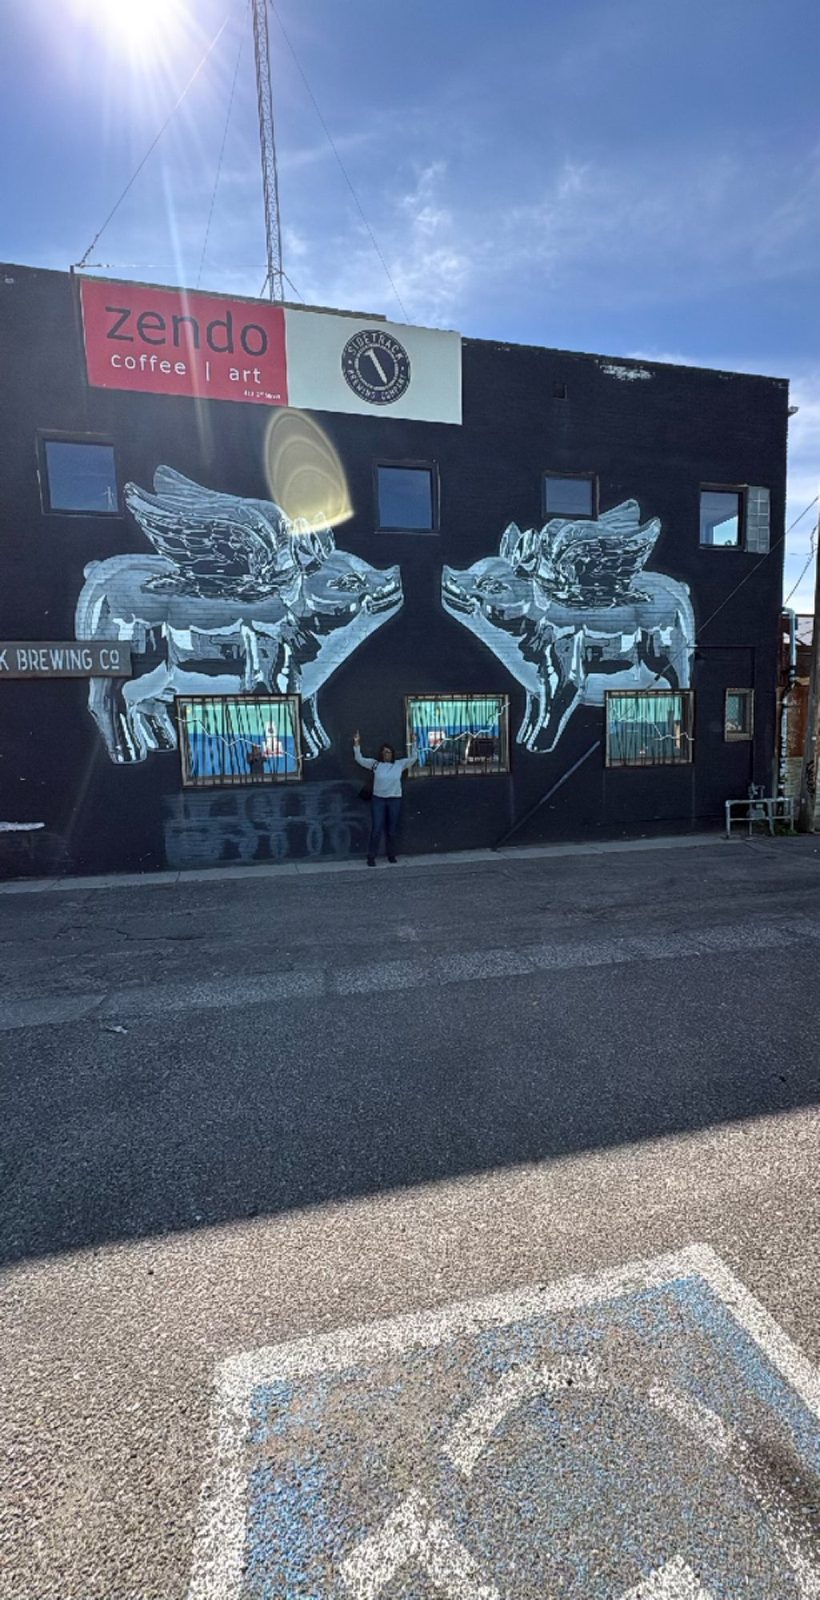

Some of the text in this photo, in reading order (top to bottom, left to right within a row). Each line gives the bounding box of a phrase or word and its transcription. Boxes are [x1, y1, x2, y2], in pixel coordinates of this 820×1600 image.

[105, 306, 268, 356] zendo
[346, 333, 404, 360] SIDETRACK
[111, 354, 187, 375] coffee
[229, 368, 261, 384] art
[17, 649, 93, 671] BREWING
